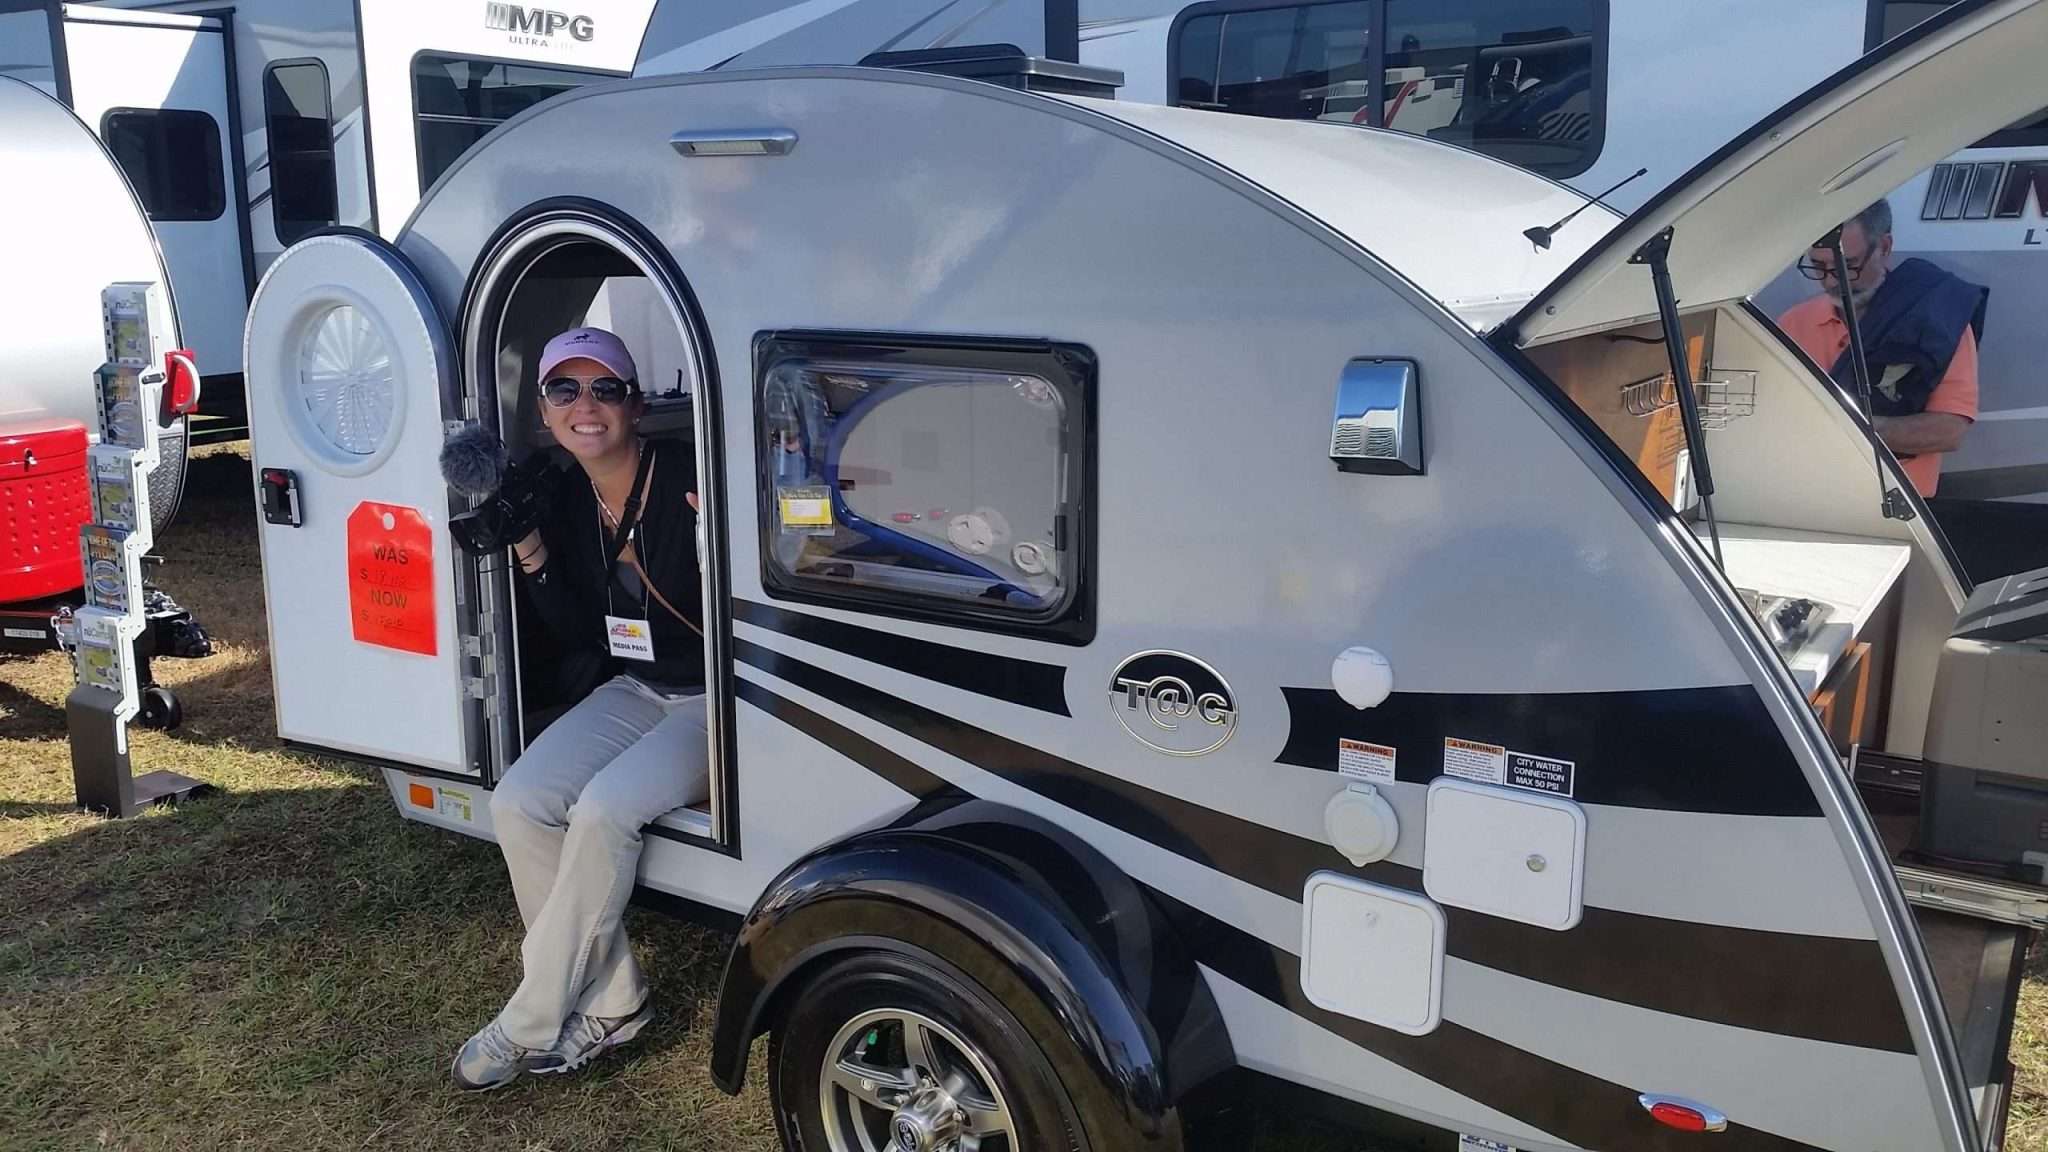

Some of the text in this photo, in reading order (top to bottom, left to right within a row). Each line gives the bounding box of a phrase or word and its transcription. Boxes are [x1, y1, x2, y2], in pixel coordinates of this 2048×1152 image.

[509, 4, 594, 42] MPG
[509, 35, 549, 47] ULTRA
[372, 544, 409, 565] WAS
[369, 589, 407, 609] NOW
[612, 642, 631, 650] MEDIA
[1118, 676, 1228, 731] T@G
[1456, 741, 1500, 754] WARNING
[1516, 758, 1563, 772] CITY WATER
[1513, 766, 1565, 782] CONNECTION
[1515, 776, 1559, 791] MAX 50 PSI
